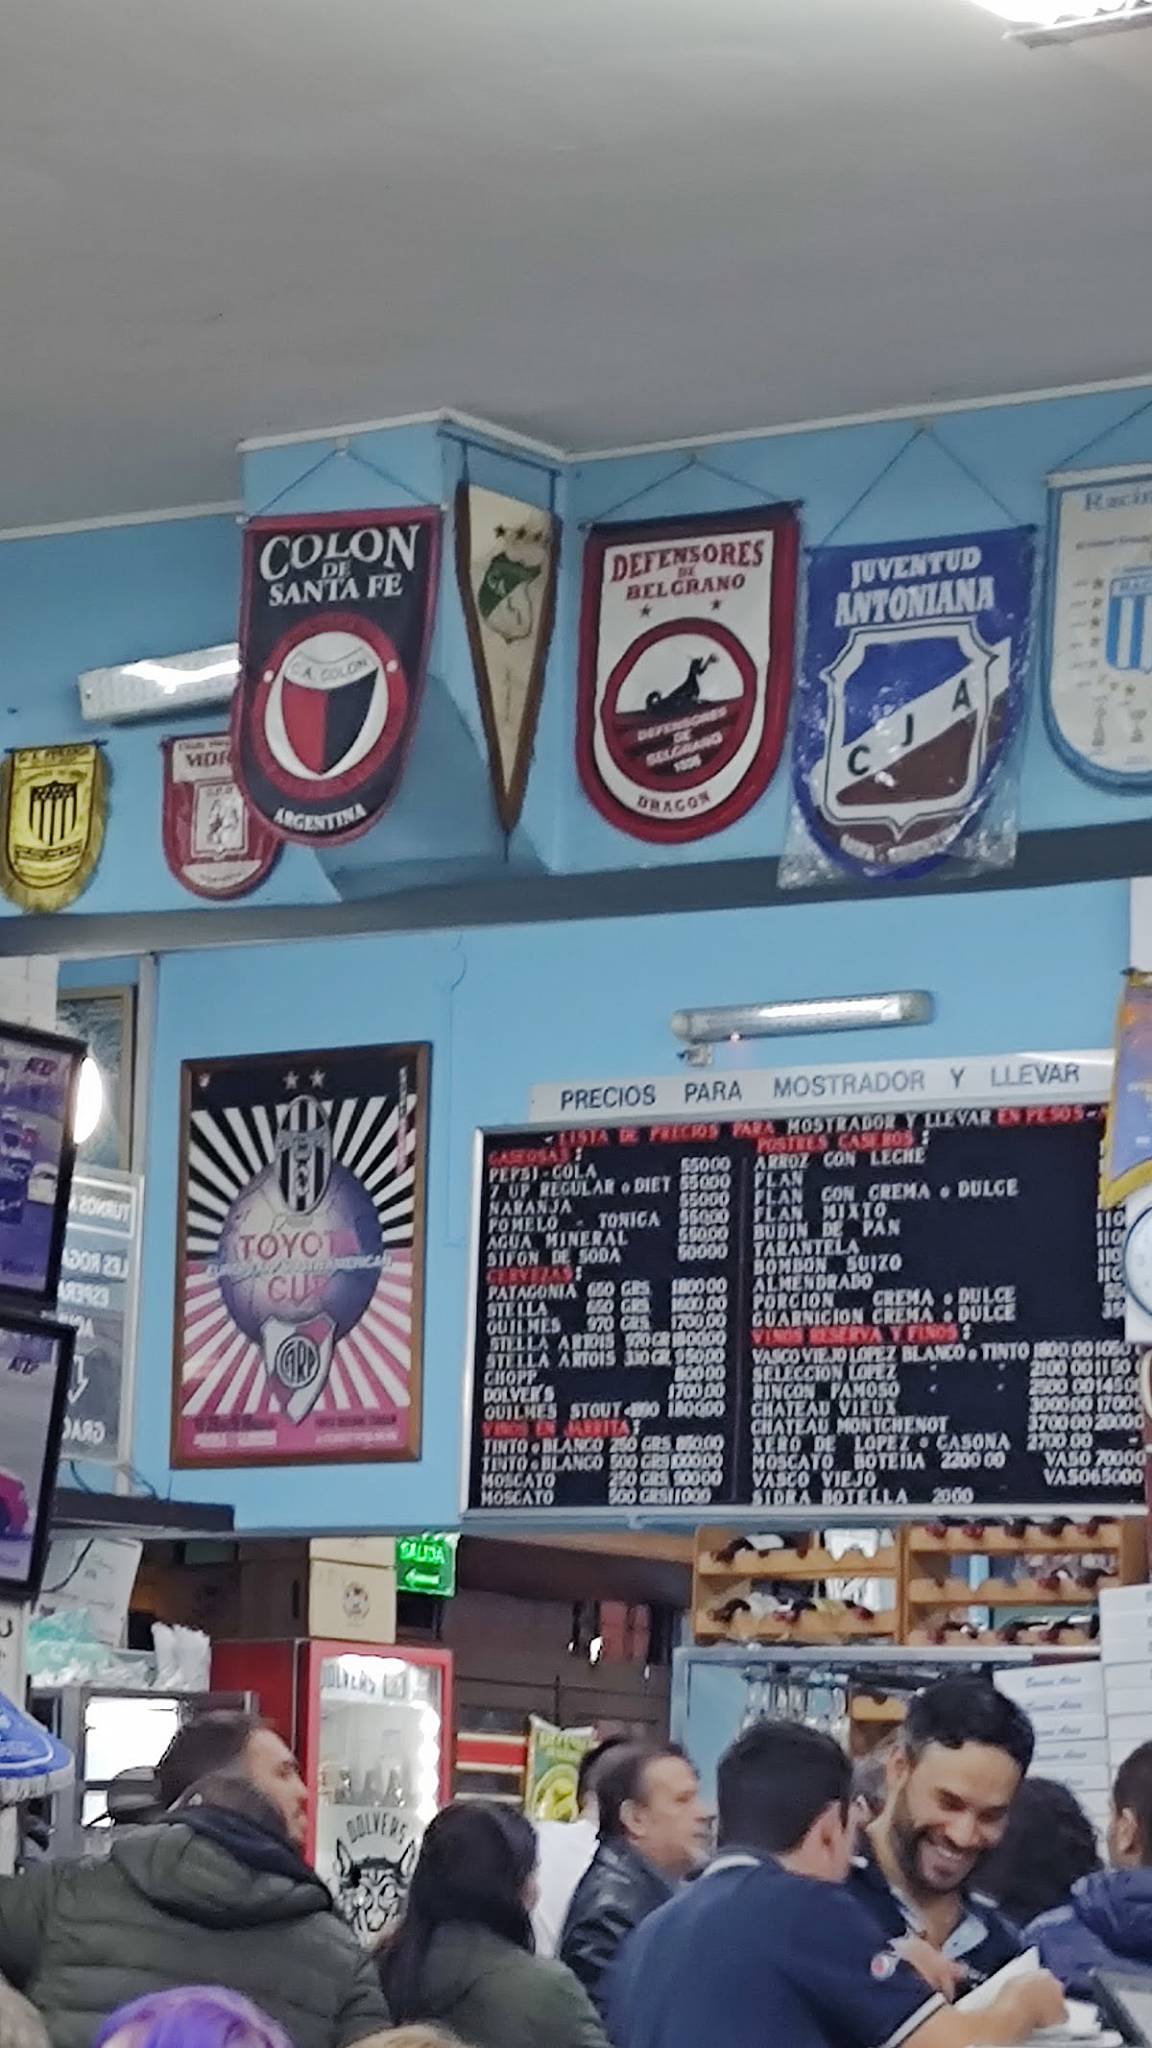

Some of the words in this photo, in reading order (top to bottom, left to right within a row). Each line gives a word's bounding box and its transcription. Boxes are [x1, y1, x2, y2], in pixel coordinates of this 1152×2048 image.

[260, 524, 420, 581] COLON
[611, 540, 765, 583] DEFENSORES
[322, 561, 350, 578] DE
[851, 545, 982, 589] JUVENTUD
[269, 578, 360, 606] SANTA
[367, 572, 403, 598] FE
[626, 573, 746, 601] BELGRANO
[835, 575, 995, 627] ANTONIANA
[847, 744, 870, 775] C
[901, 714, 914, 747] J
[952, 678, 971, 711] A
[636, 790, 711, 813] DRAGON
[272, 803, 367, 831] ARGENTINA
[560, 1084, 656, 1111] PRECIOS
[684, 1080, 742, 1104] PARA
[773, 1069, 925, 1099] MOSTRADOR
[951, 1066, 965, 1089] Y
[990, 1062, 1080, 1087] LLEVAR
[559, 1128, 609, 1147] LISTA
[649, 1123, 719, 1143] PRECIOS
[787, 1114, 896, 1134] MOSTRADOR
[906, 1112, 916, 1129] Y
[925, 1108, 992, 1128] LLEVAR
[753, 1153, 811, 1172] ARROZ
[822, 1151, 856, 1169] CON
[870, 1147, 927, 1167] LECHE
[489, 1184, 500, 1199] 7
[508, 1182, 530, 1199] UP
[539, 1177, 615, 1198] REGULAR
[634, 1175, 672, 1193] DIET
[754, 1171, 804, 1189] FLAN
[753, 1189, 804, 1206] FLAN
[821, 1186, 855, 1204] CON
[868, 1182, 931, 1201] CREMA
[957, 1178, 1019, 1198] DULCE
[487, 1198, 573, 1217] NARANJA
[753, 1205, 803, 1223] FLAN
[822, 1202, 888, 1221] MIXTO
[487, 1215, 560, 1234] POMELO
[599, 1210, 661, 1229] TONICA
[752, 1222, 809, 1241] BUDIN
[822, 1220, 843, 1239] DE
[862, 1219, 901, 1238] PAN
[486, 1232, 533, 1250] AGUA
[545, 1229, 629, 1249] MINERAL
[753, 1238, 861, 1258] TARANTELA
[486, 1250, 540, 1267] SIFON
[552, 1248, 571, 1265] DE
[579, 1247, 622, 1265] SODA
[752, 1256, 828, 1276] BOMBON
[845, 1253, 903, 1273] SUIZO
[486, 1283, 579, 1301] PATAGONIA
[752, 1272, 875, 1293] ALMENDRADO
[752, 1292, 836, 1311] PORCION
[872, 1288, 935, 1308] CREMA
[957, 1286, 1017, 1305] DULCE
[486, 1301, 548, 1319] STELLA
[751, 1307, 864, 1327] GUARNICION
[871, 1305, 934, 1324] CREMA
[957, 1303, 1017, 1322] DULCE
[490, 1334, 550, 1352] STELLA
[558, 1331, 615, 1351] ARTOIS
[485, 1352, 550, 1369] STELLA
[558, 1349, 617, 1367] ARTOIS
[751, 1348, 800, 1365] VASCO
[802, 1347, 847, 1364] VIEJO
[850, 1346, 897, 1364] LOPEZ
[902, 1344, 966, 1363] BLANCO
[981, 1342, 1031, 1361] TINTO
[484, 1369, 538, 1386] CHOPP
[751, 1363, 844, 1383] SELECCION
[849, 1362, 898, 1381] LOPEZ
[751, 1383, 816, 1401] RINCON
[569, 1402, 621, 1420] STOUT
[750, 1401, 830, 1418] CHATEAU
[838, 1398, 897, 1417] VIEUX
[750, 1418, 830, 1436] CHATEAU
[837, 1415, 950, 1434] MONTCHENOT
[482, 1438, 529, 1456] TINTO
[542, 1436, 605, 1454] BLANCO
[814, 1434, 837, 1452] DE
[854, 1434, 910, 1452] LOPEZ
[935, 1432, 1011, 1451] CASONA
[481, 1455, 529, 1473] TINTO
[541, 1453, 605, 1472] BLANCO
[751, 1453, 835, 1471] MOSCATO
[1044, 1450, 1092, 1468] VASO
[480, 1472, 556, 1490] MOSCATO
[751, 1471, 810, 1488] VASCO
[821, 1470, 877, 1488] VIEJO
[480, 1489, 554, 1507] MOSCATO
[751, 1488, 811, 1505] SIDRA
[822, 1487, 909, 1505] BOTELLA
